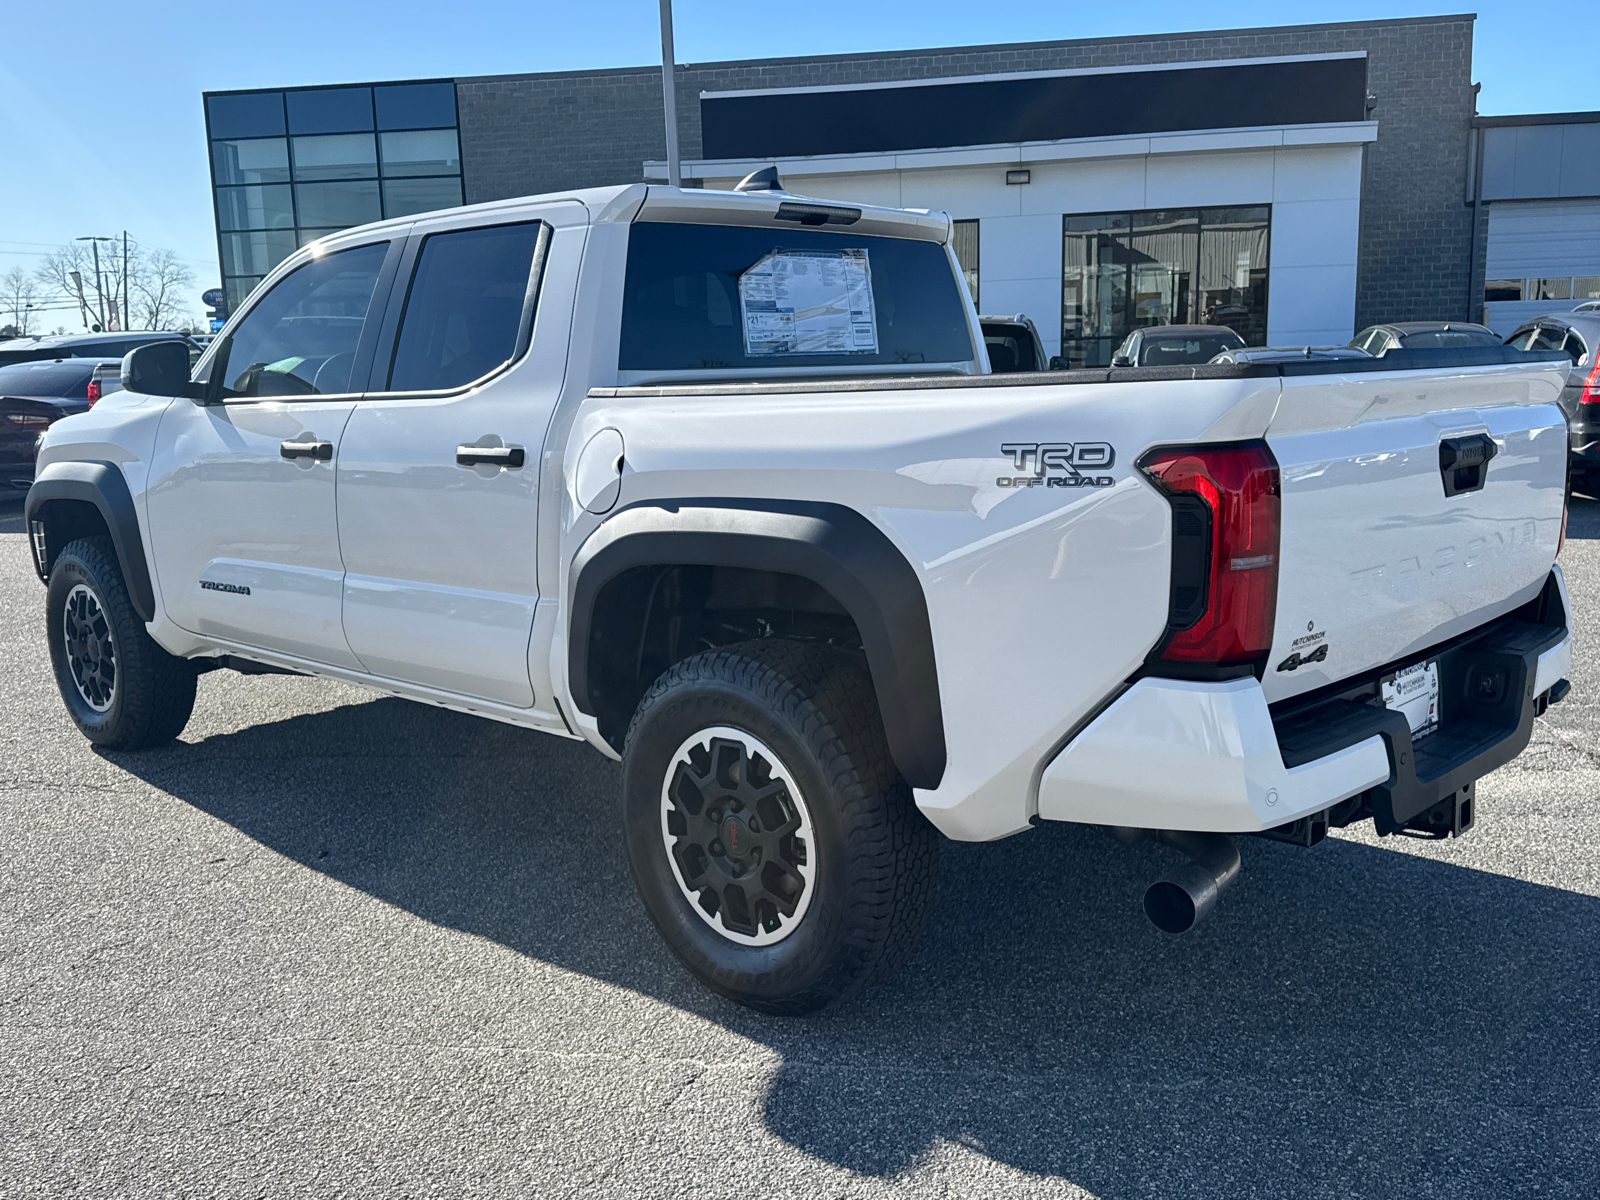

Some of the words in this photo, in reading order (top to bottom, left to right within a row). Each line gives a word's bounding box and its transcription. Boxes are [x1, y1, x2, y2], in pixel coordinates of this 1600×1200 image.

[750, 315, 759, 324] 21
[1001, 442, 1116, 478] TRD
[1462, 446, 1484, 460] TOYOTA
[996, 476, 1043, 488] OFF
[1046, 476, 1116, 488] ROAD
[199, 580, 251, 595] TACOMA
[1291, 630, 1327, 647] HUTCHINSON
